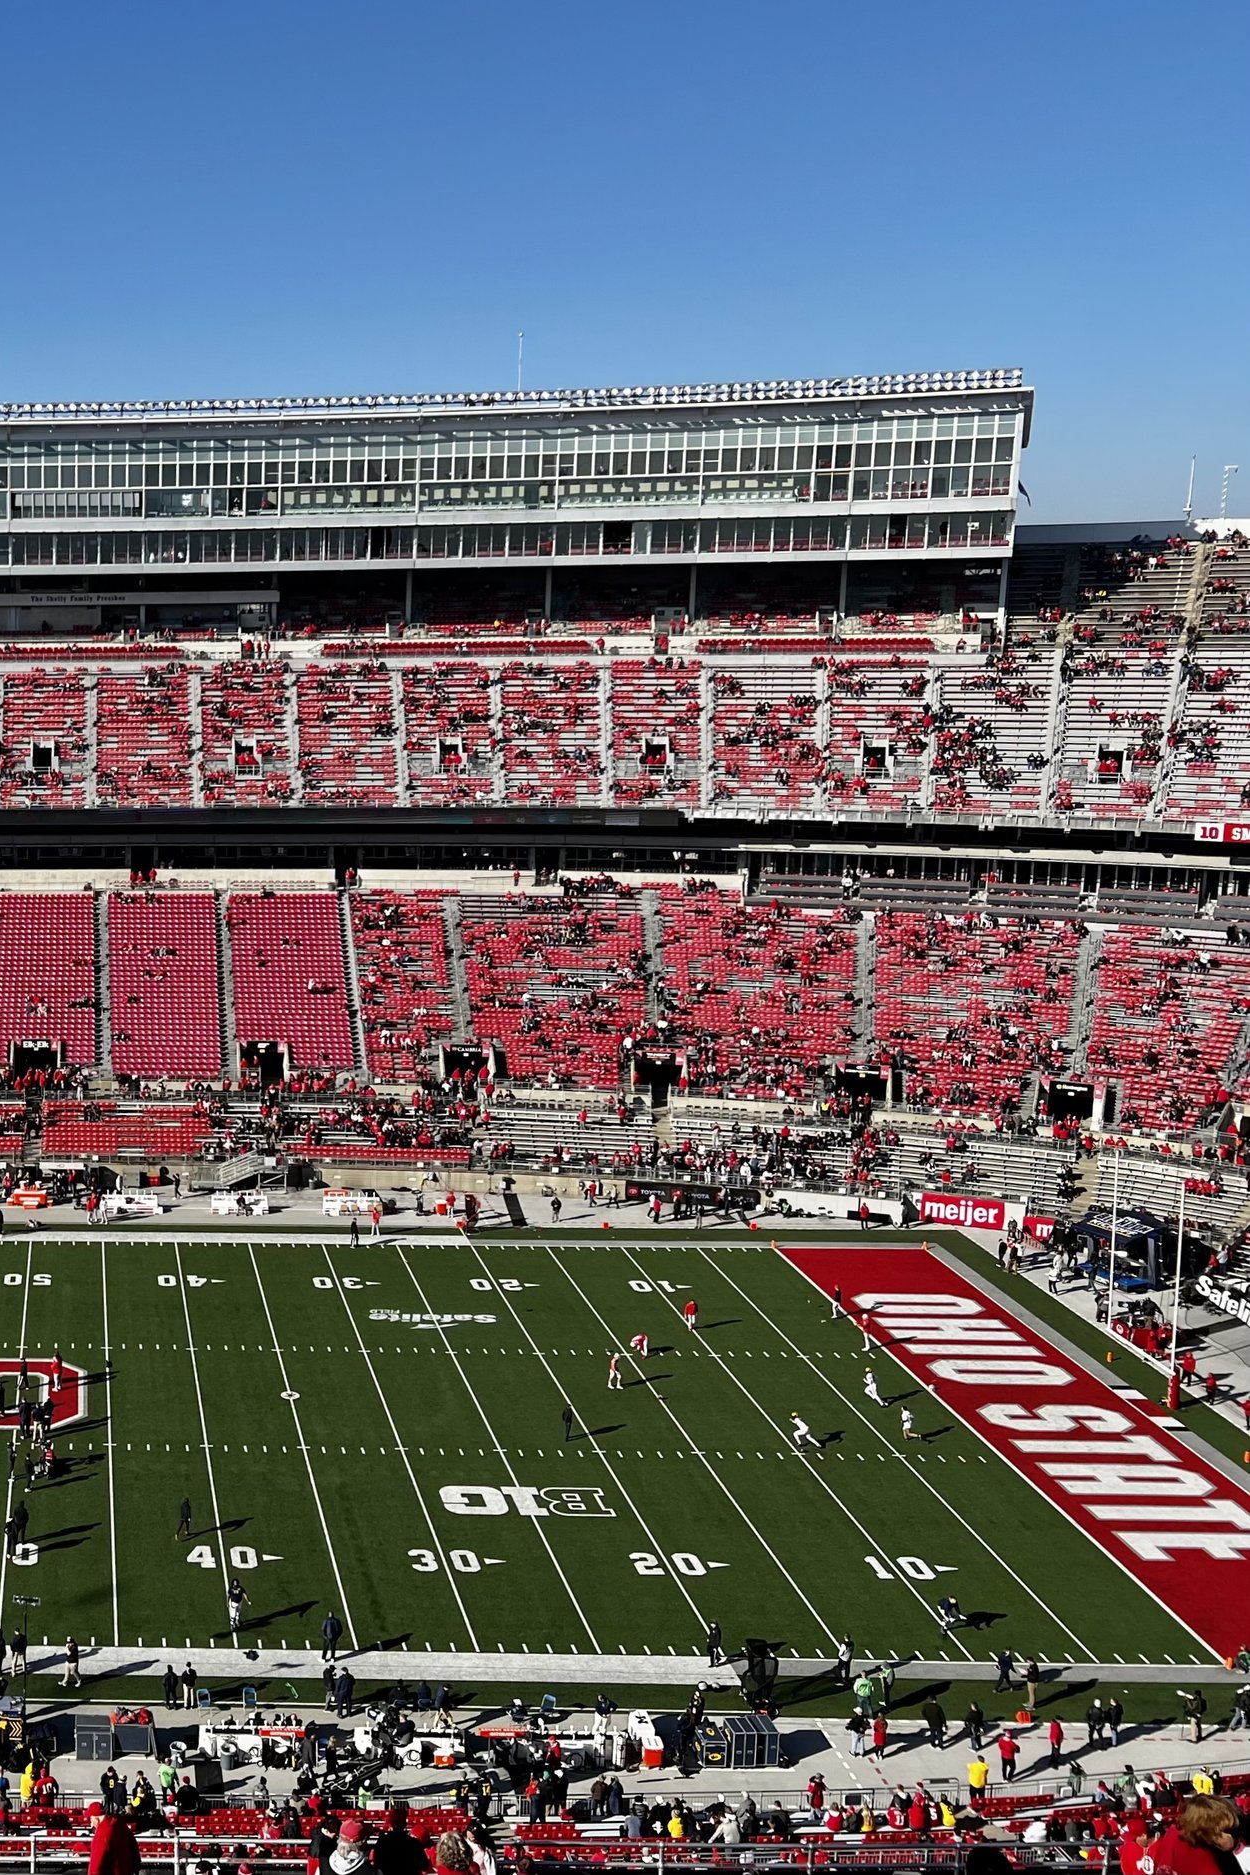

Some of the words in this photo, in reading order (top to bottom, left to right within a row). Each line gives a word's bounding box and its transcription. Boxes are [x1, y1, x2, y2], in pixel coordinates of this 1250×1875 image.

[70, 594, 93, 603] Family
[1200, 826, 1219, 840] 10
[924, 1199, 1000, 1226] meijer
[3, 1273, 53, 1287] 50
[156, 1274, 209, 1288] 40
[312, 1276, 365, 1290] 30
[469, 1278, 524, 1291] 20
[627, 1280, 679, 1293] 10
[368, 1312, 497, 1324] Safelite
[851, 1292, 1077, 1387] OHIO
[976, 1402, 1250, 1562] STATE
[186, 1545, 260, 1569] 40
[405, 1548, 483, 1573] 30
[628, 1552, 708, 1576] 20
[863, 1555, 938, 1581] 10
[42, 1782, 52, 1795] 10
